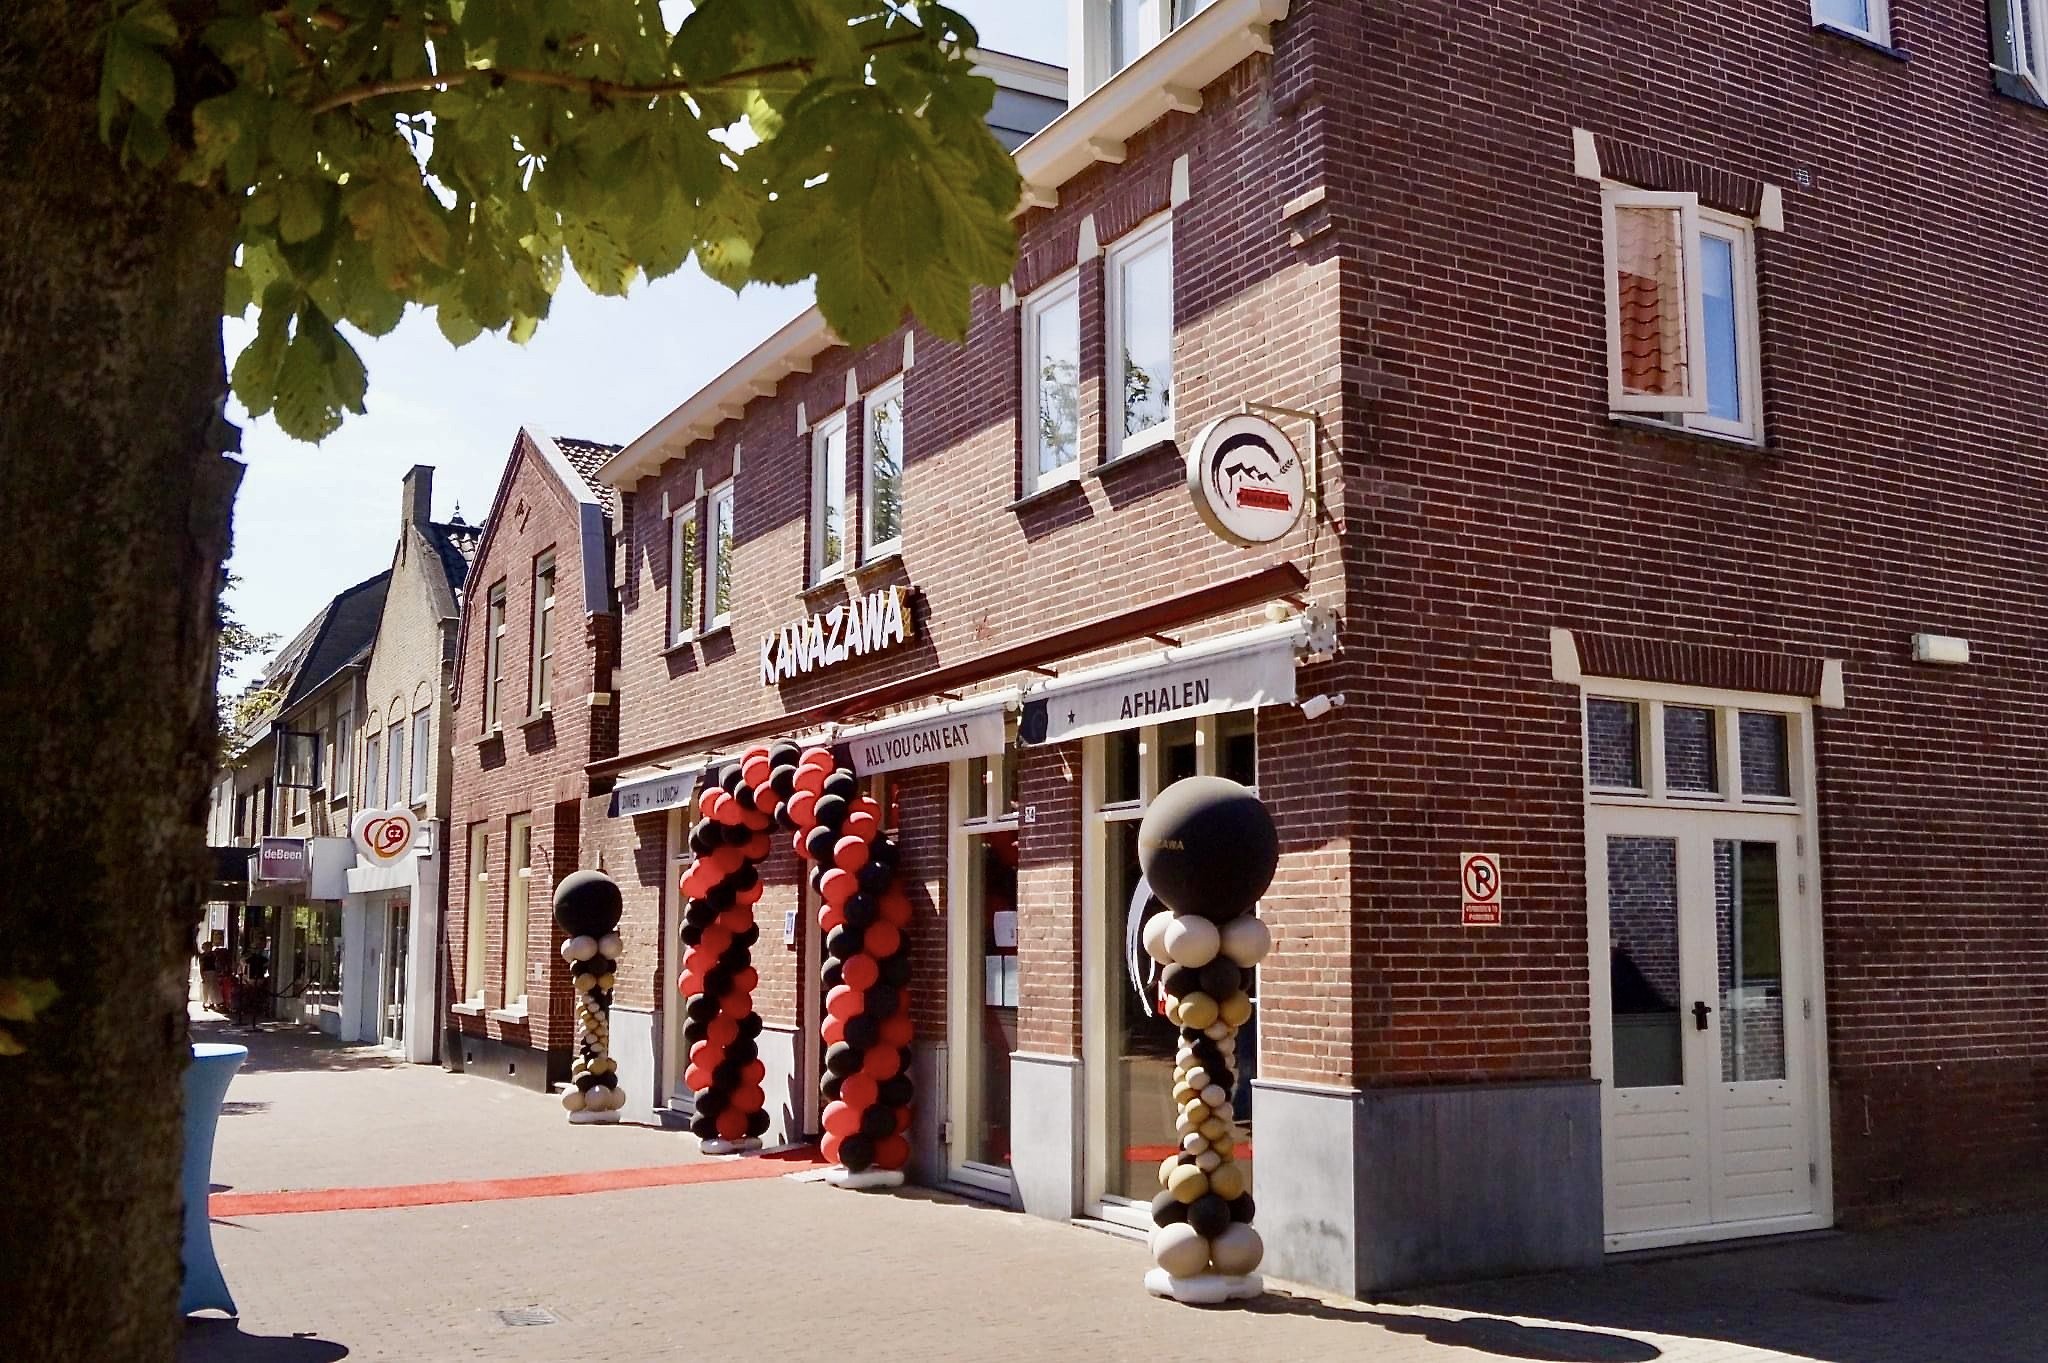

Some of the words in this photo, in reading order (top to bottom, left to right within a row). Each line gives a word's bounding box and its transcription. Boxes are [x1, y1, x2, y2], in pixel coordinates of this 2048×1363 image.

[760, 584, 904, 687] KANAZAWA
[1120, 678, 1209, 720] AFHALEN
[865, 744, 885, 767] ALL
[885, 735, 911, 760] YOU
[913, 729, 941, 754] CAN
[942, 723, 969, 749] EAT
[656, 784, 679, 804] LUNCH
[388, 829, 401, 838] CZ
[264, 849, 302, 860] deBeen
[1475, 865, 1491, 894] P
